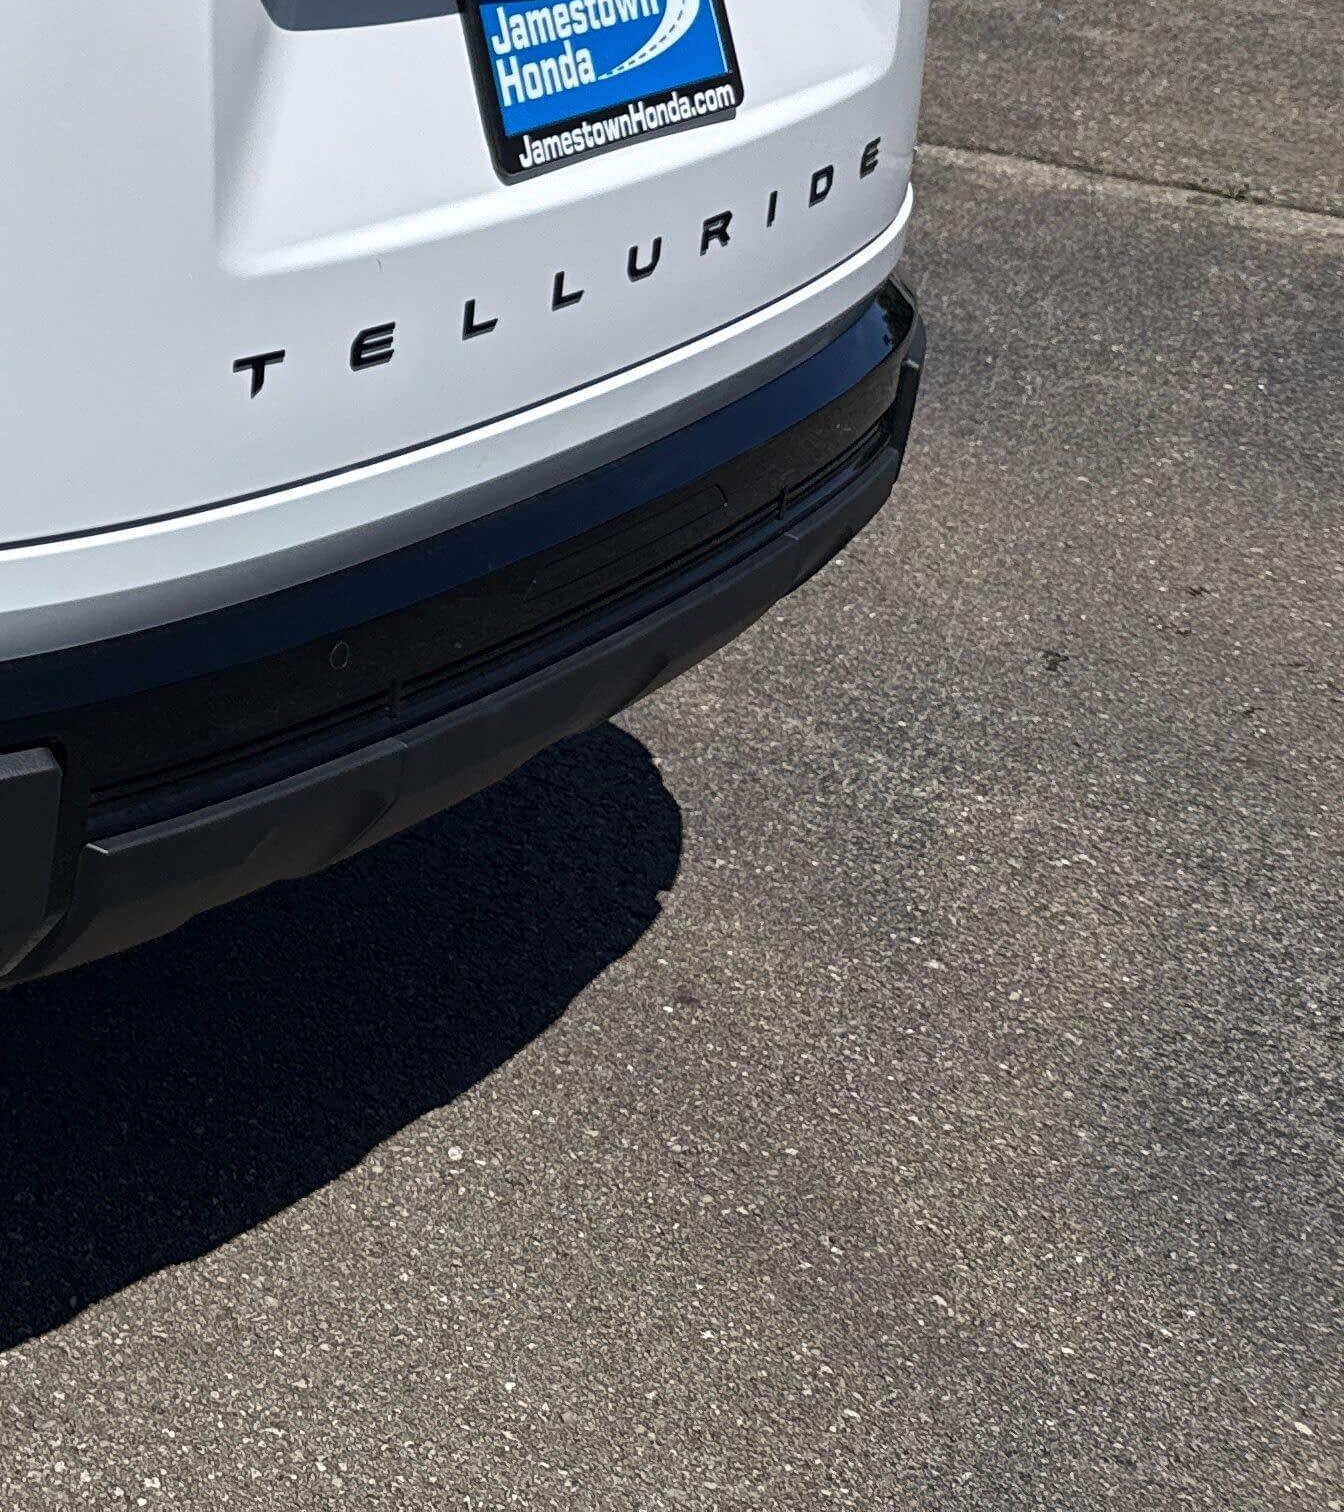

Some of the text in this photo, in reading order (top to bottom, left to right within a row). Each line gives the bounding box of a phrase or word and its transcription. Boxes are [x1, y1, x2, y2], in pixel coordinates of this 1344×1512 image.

[496, 40, 597, 107] Honda
[519, 83, 736, 168] JamestownHonda.com
[232, 136, 881, 398] TELLURIDE
